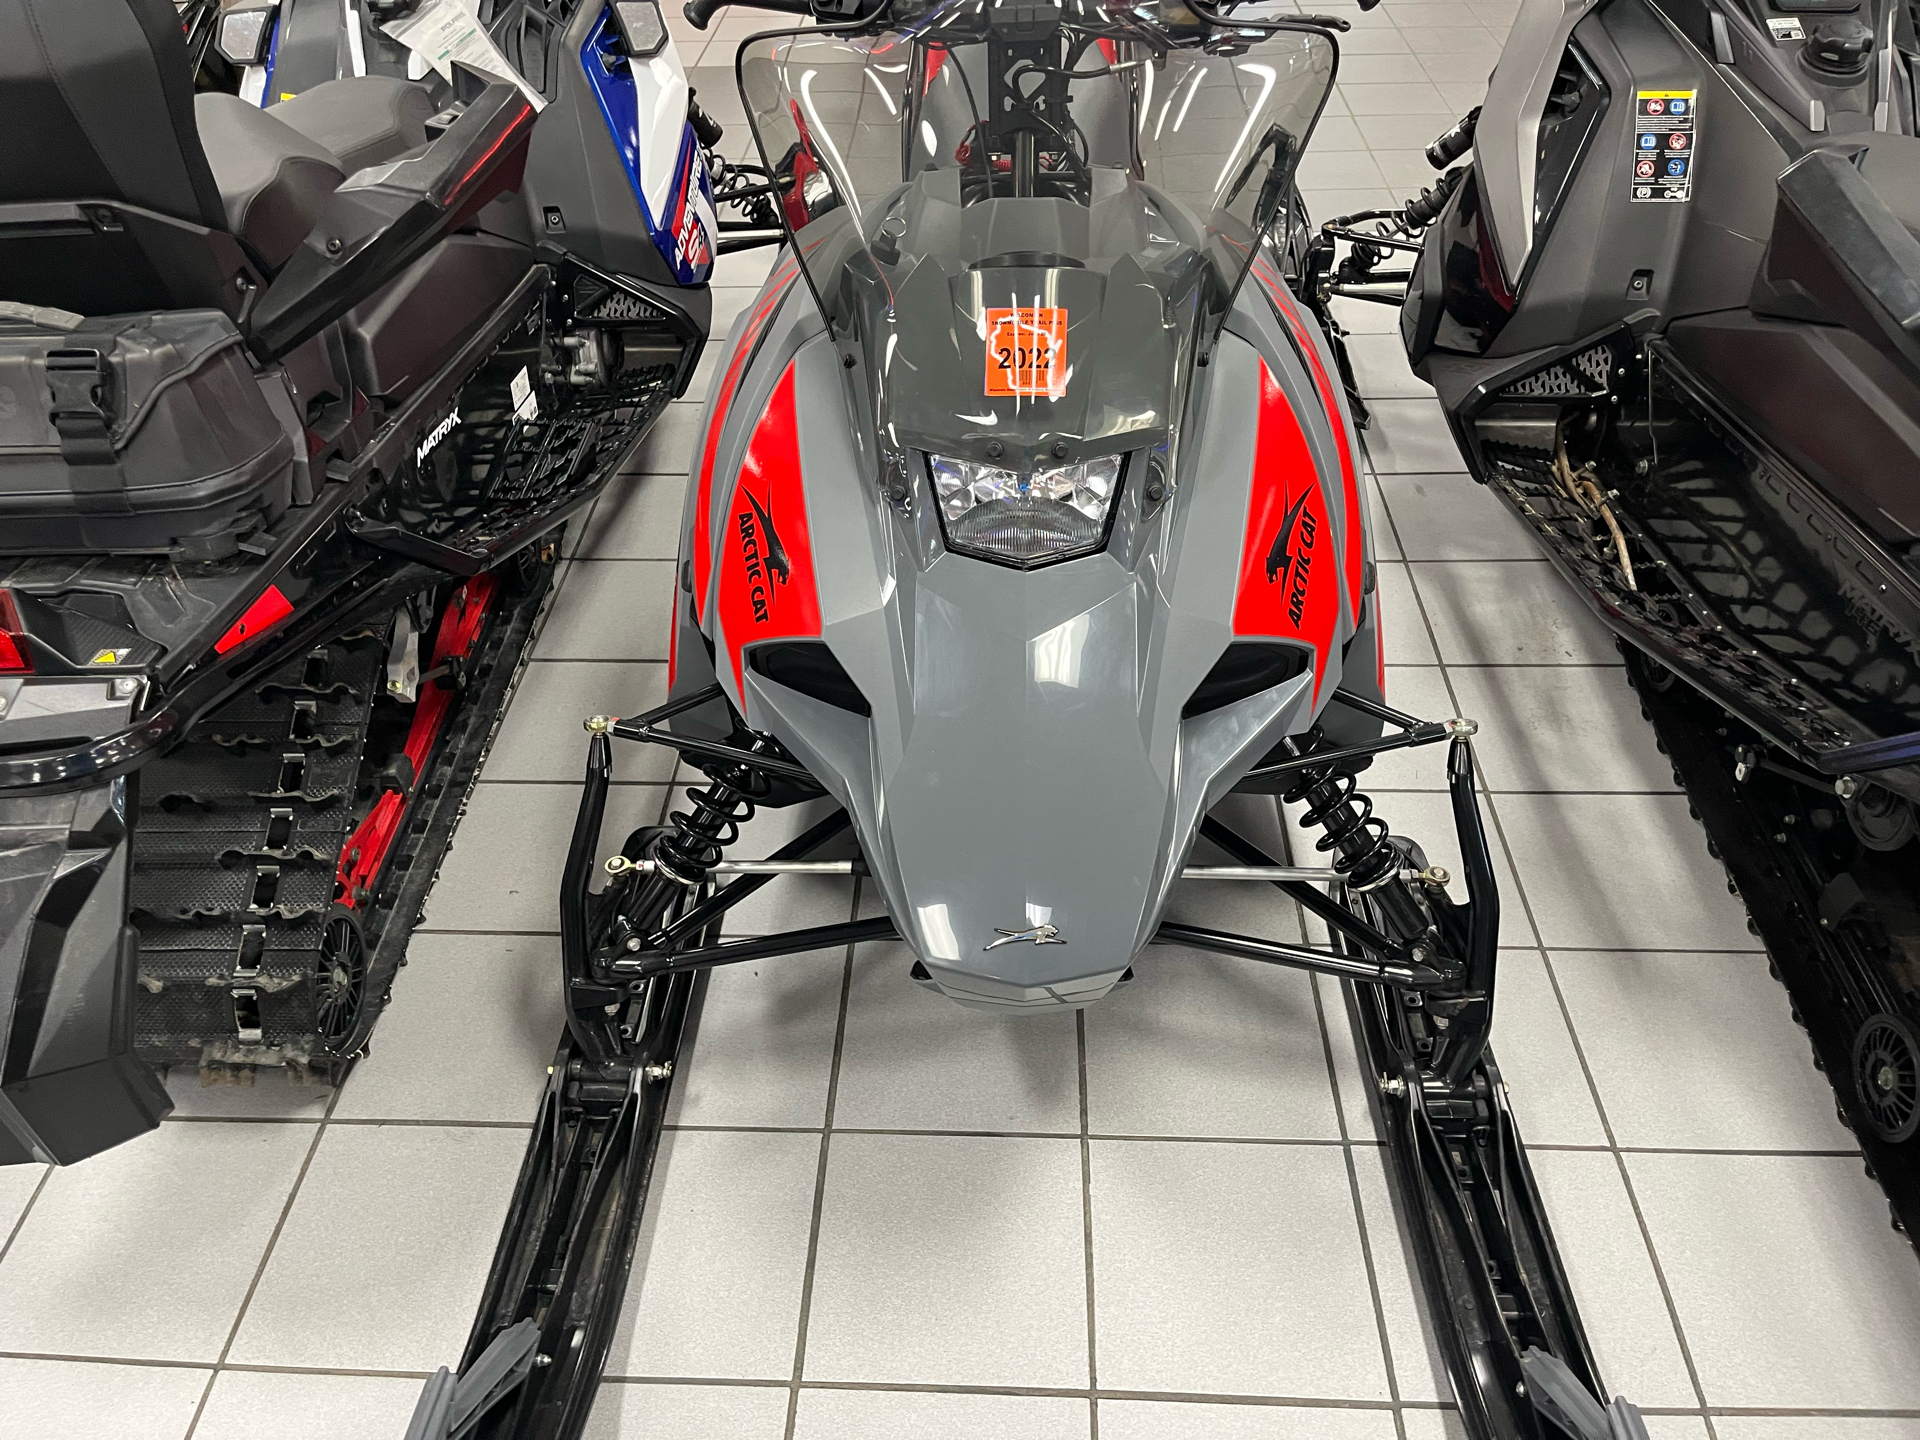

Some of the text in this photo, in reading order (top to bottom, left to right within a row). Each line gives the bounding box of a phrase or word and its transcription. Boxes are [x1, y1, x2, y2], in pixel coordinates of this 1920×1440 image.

[675, 148, 702, 271] ADVENTURE
[998, 347, 1057, 369] 2022
[416, 407, 462, 468] MATRYX
[738, 511, 769, 623] ARCTIC CAT
[1288, 504, 1318, 632] ARCTIC CAT
